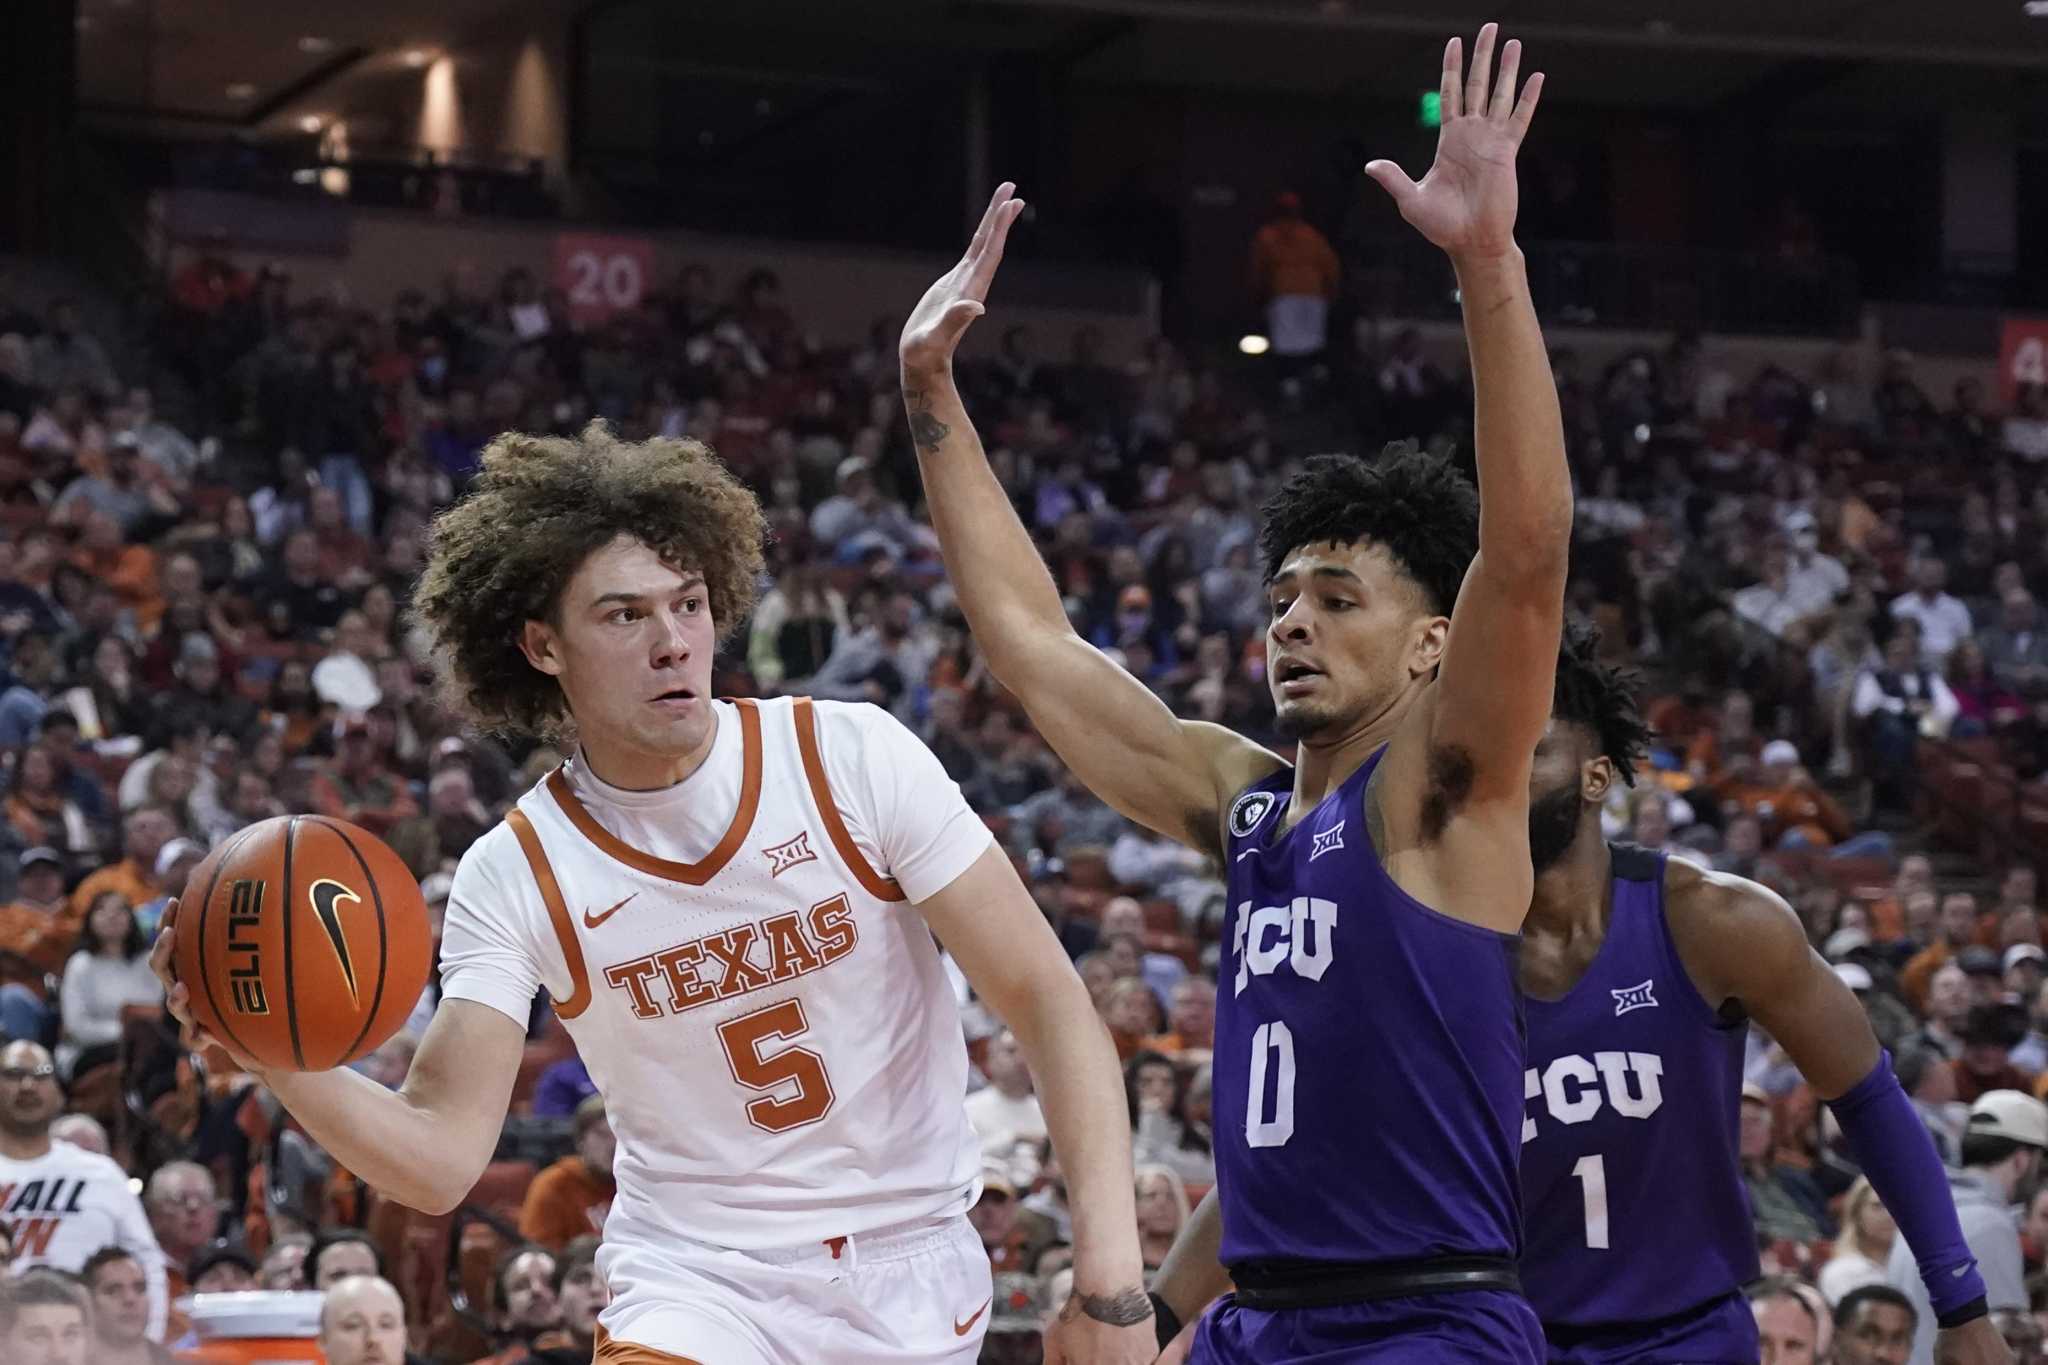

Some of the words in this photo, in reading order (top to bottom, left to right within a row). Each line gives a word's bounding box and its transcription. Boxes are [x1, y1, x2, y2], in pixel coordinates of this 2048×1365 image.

[567, 252, 641, 306] 20
[228, 879, 270, 1015] ELITE
[603, 892, 859, 1019] TEXAS
[715, 996, 836, 1134] 5
[1245, 1020, 1296, 1149] 0
[1571, 1153, 1610, 1250] 1
